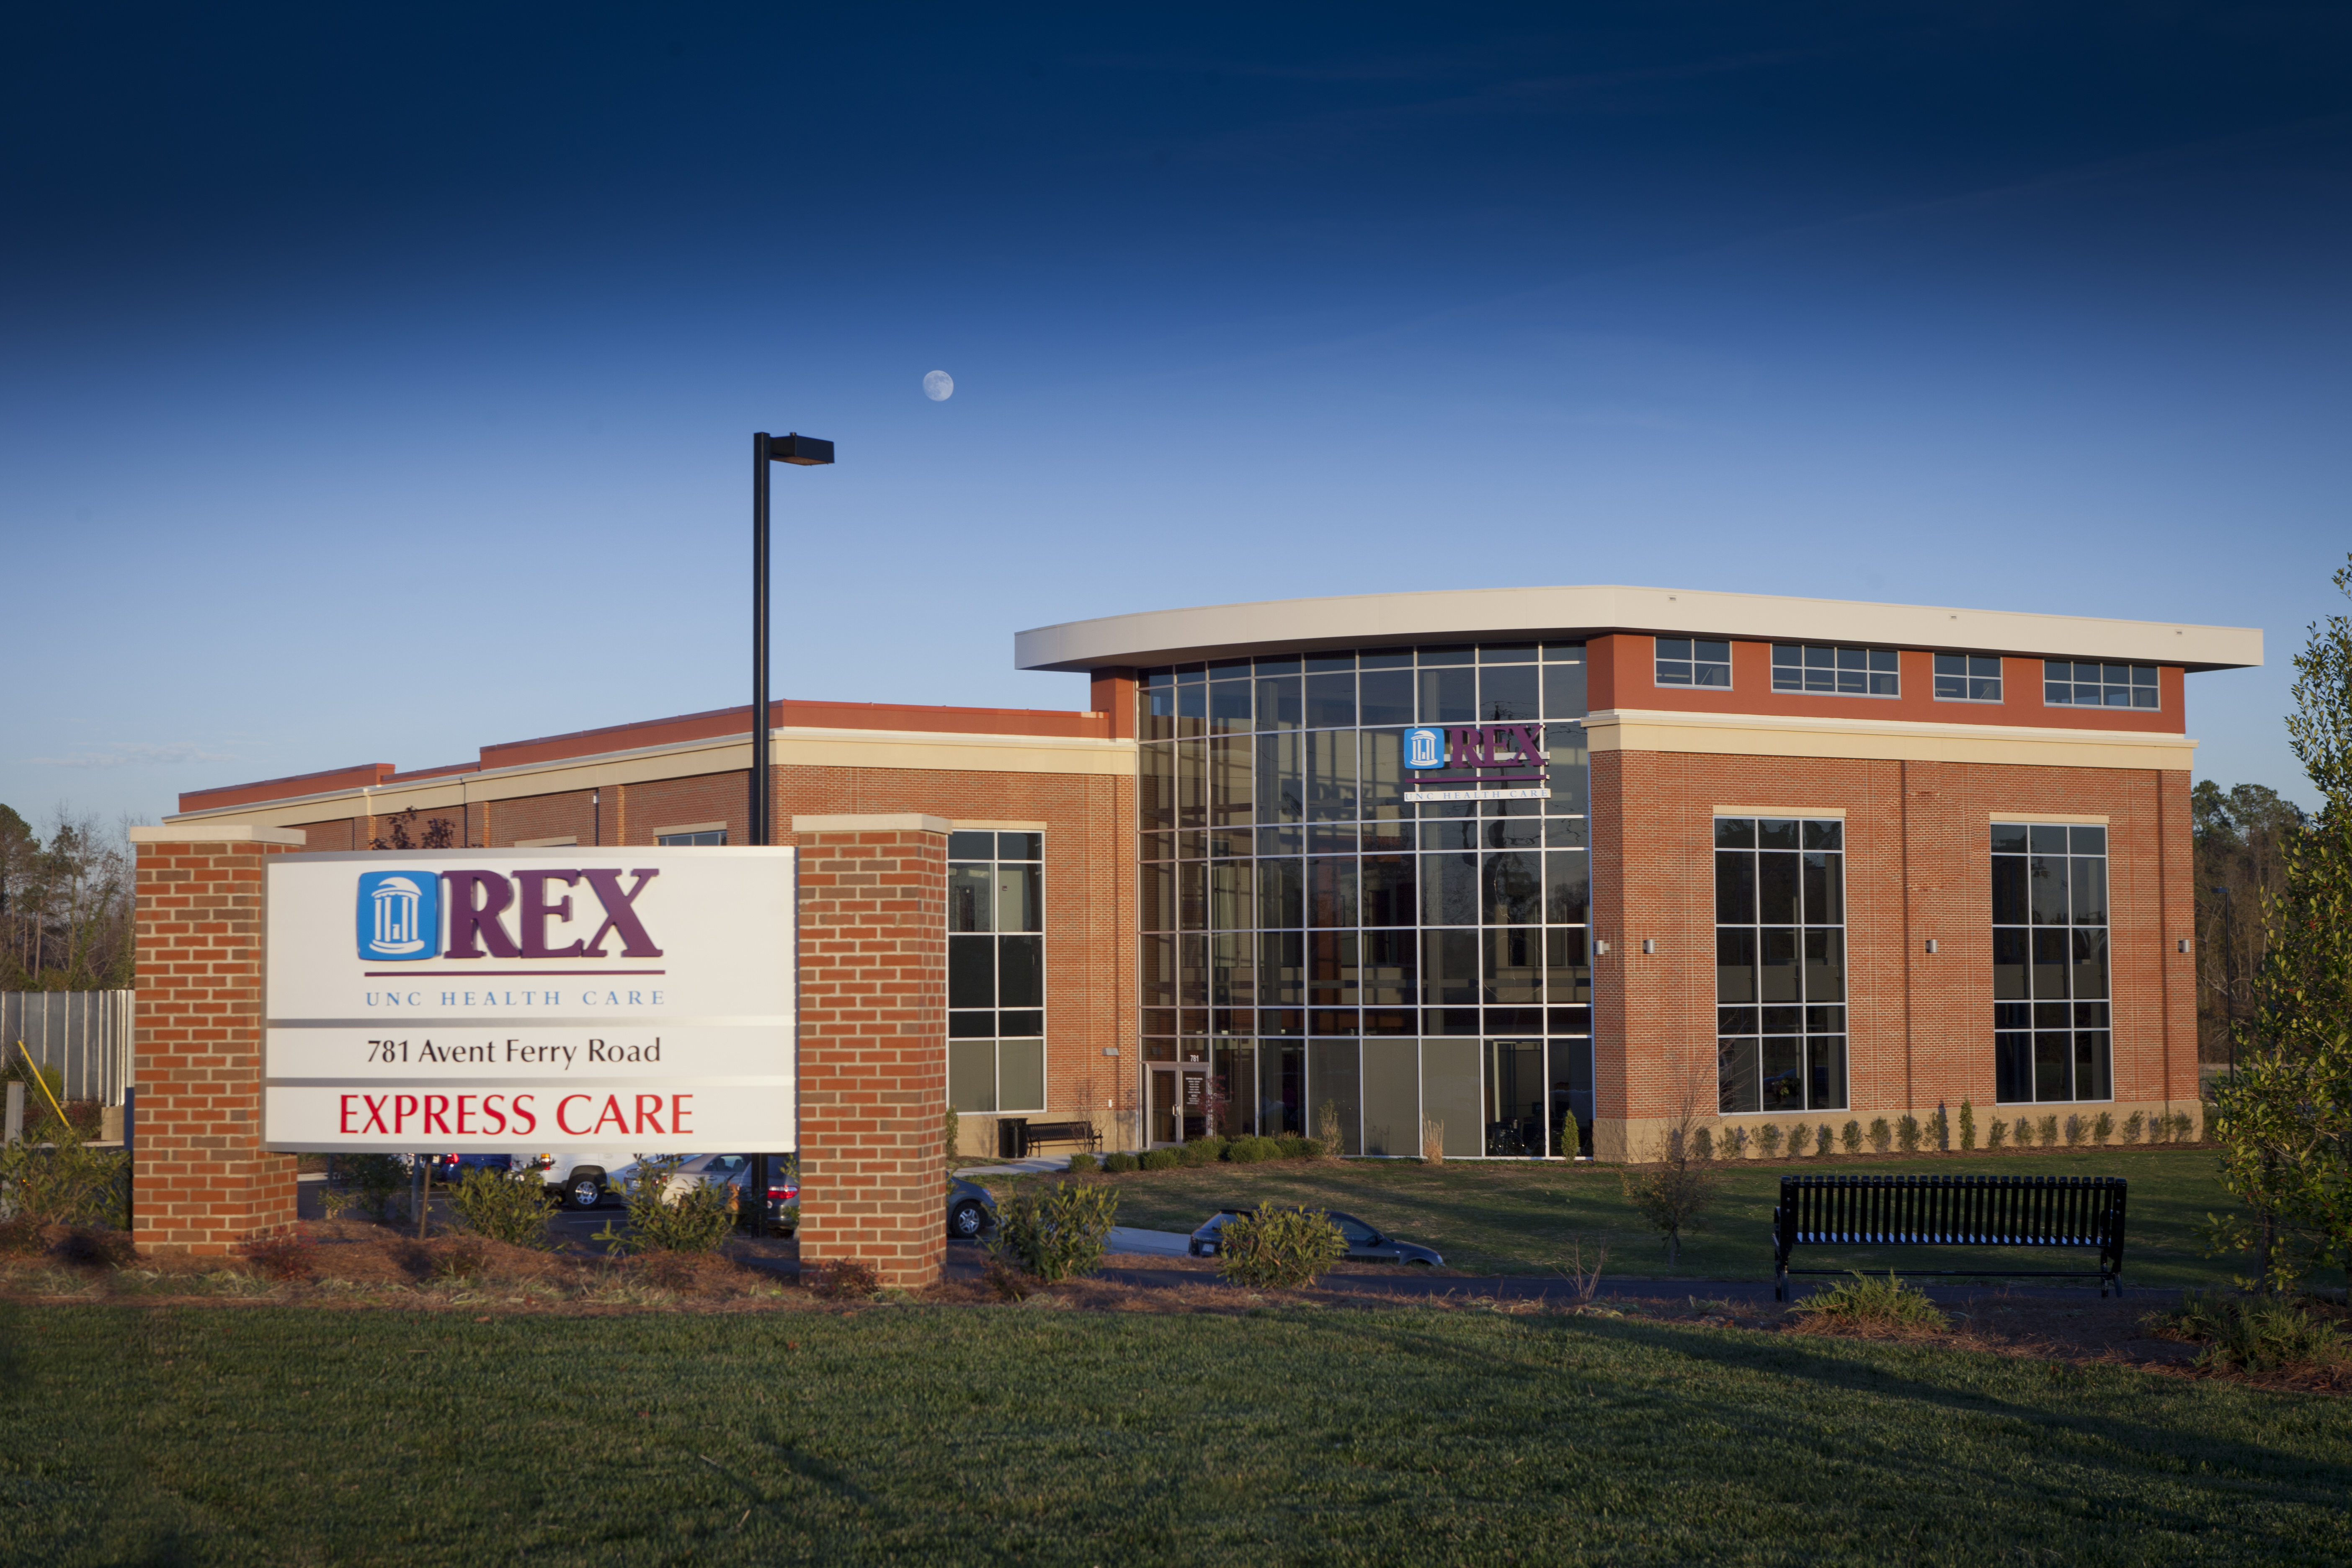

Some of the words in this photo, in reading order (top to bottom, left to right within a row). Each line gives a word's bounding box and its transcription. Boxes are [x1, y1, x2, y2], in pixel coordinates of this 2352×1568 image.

[1447, 725, 1547, 767] REX
[441, 868, 664, 959] REX
[366, 991, 421, 1006] UNC
[441, 991, 560, 1006] HEALTH
[583, 990, 665, 1005] CARE
[367, 1040, 408, 1063] 781
[418, 1039, 496, 1063] Avent
[506, 1039, 577, 1070] Ferry
[588, 1037, 660, 1063] Road
[340, 1094, 536, 1135] EXPRESS
[556, 1093, 694, 1135] CARE
